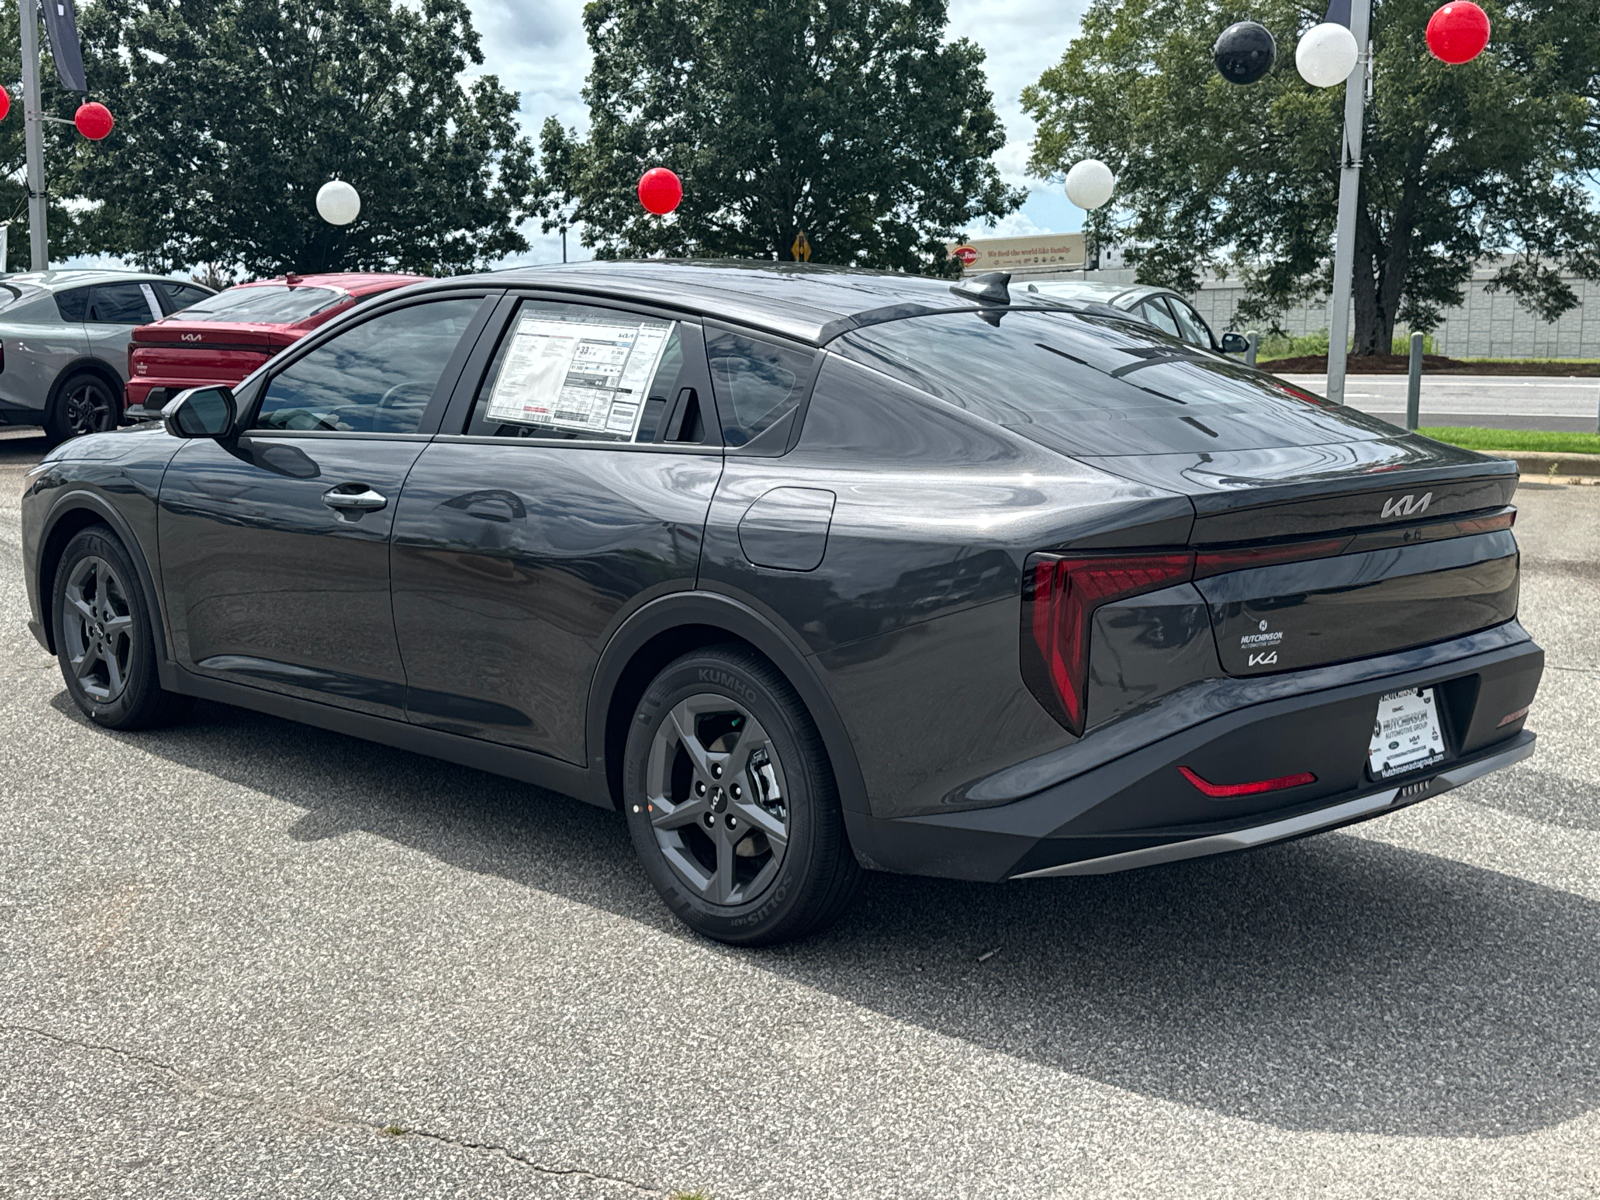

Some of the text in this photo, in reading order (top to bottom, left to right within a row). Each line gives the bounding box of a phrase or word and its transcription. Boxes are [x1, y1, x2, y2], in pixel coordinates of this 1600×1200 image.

[987, 250, 997, 258] We
[1021, 247, 1038, 255] world
[181, 333, 202, 341] KIA
[580, 346, 590, 355] 33
[1380, 492, 1433, 518] KIA
[1240, 631, 1284, 644] HUTCHINSON
[1248, 650, 1278, 667] K4
[698, 668, 757, 703] KUMHO
[1382, 709, 1429, 733] HUTCHINSON
[1385, 721, 1428, 740] AUTOMOTIVE GROUP
[747, 872, 793, 927] SOLUS
